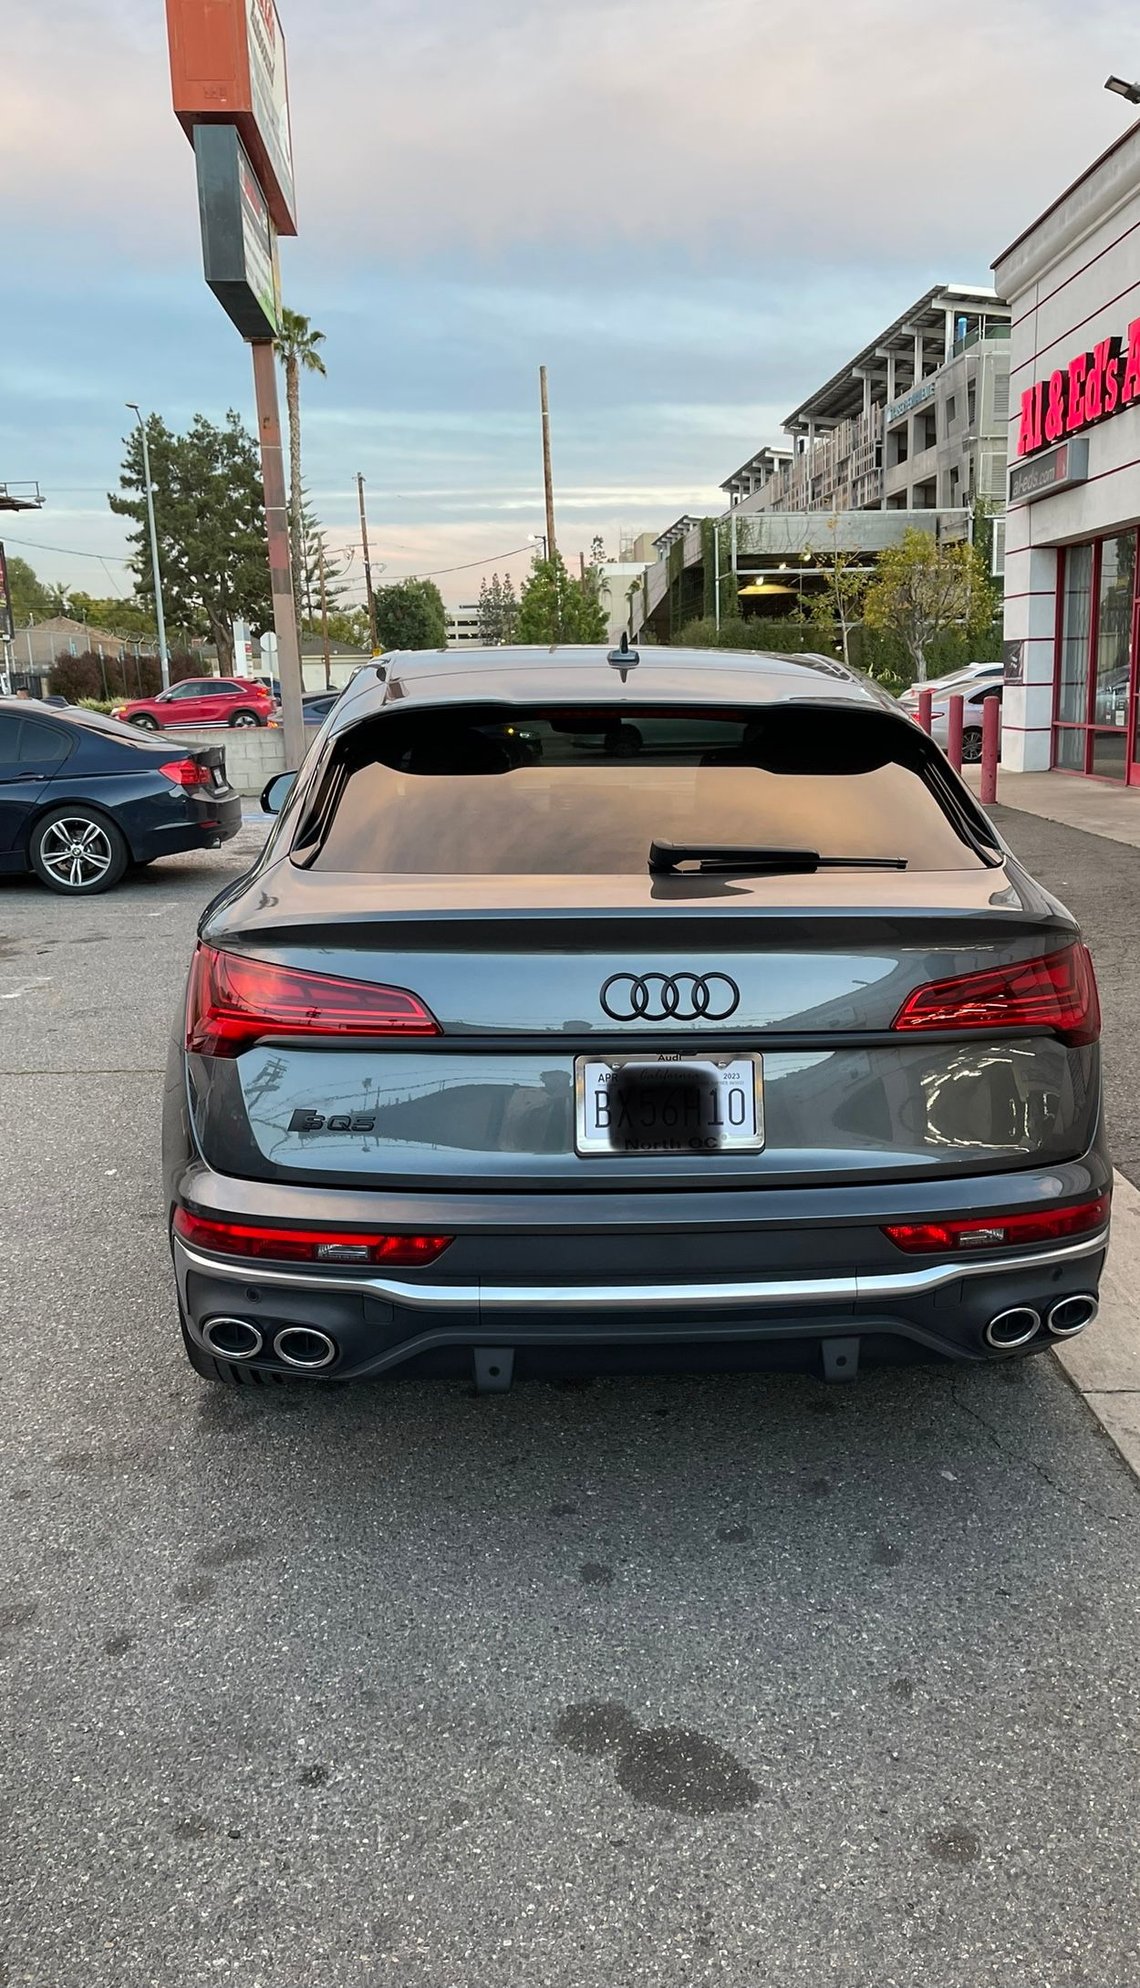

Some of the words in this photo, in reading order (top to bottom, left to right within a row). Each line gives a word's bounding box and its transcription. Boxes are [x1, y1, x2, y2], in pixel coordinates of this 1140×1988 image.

[1017, 380, 1042, 456] Al
[1045, 369, 1064, 442] &
[1066, 337, 1118, 432] Ed's
[657, 1053, 682, 1062] Audi
[597, 1072, 618, 1083] APR
[723, 1072, 741, 1080] 2023
[301, 1113, 376, 1132] SQ5
[624, 1136, 681, 1150] North
